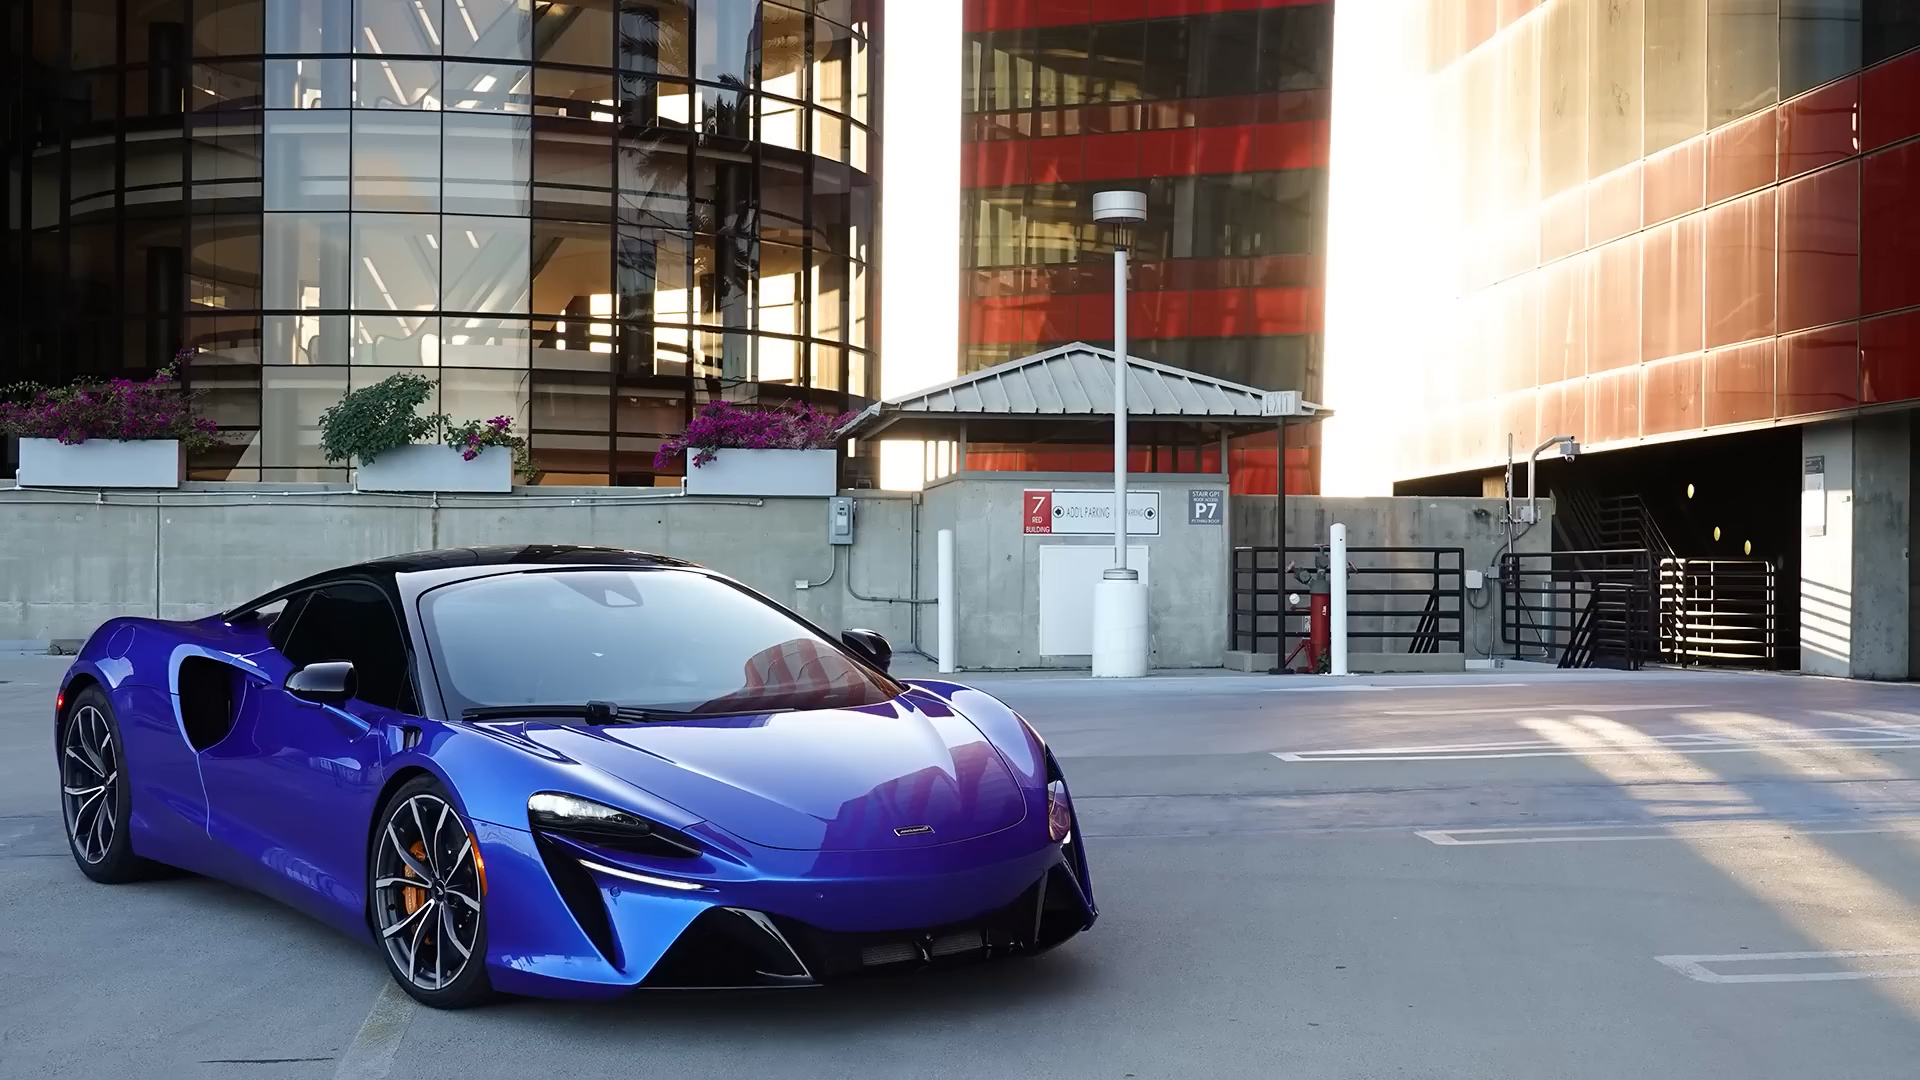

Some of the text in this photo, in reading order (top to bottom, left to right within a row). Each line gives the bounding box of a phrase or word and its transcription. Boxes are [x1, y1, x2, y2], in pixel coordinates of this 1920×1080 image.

[1266, 393, 1290, 413] EXIT
[1032, 496, 1046, 514] 7
[1084, 506, 1110, 518] PARKING
[1126, 508, 1144, 517] ARKING
[1196, 502, 1217, 518] P7
